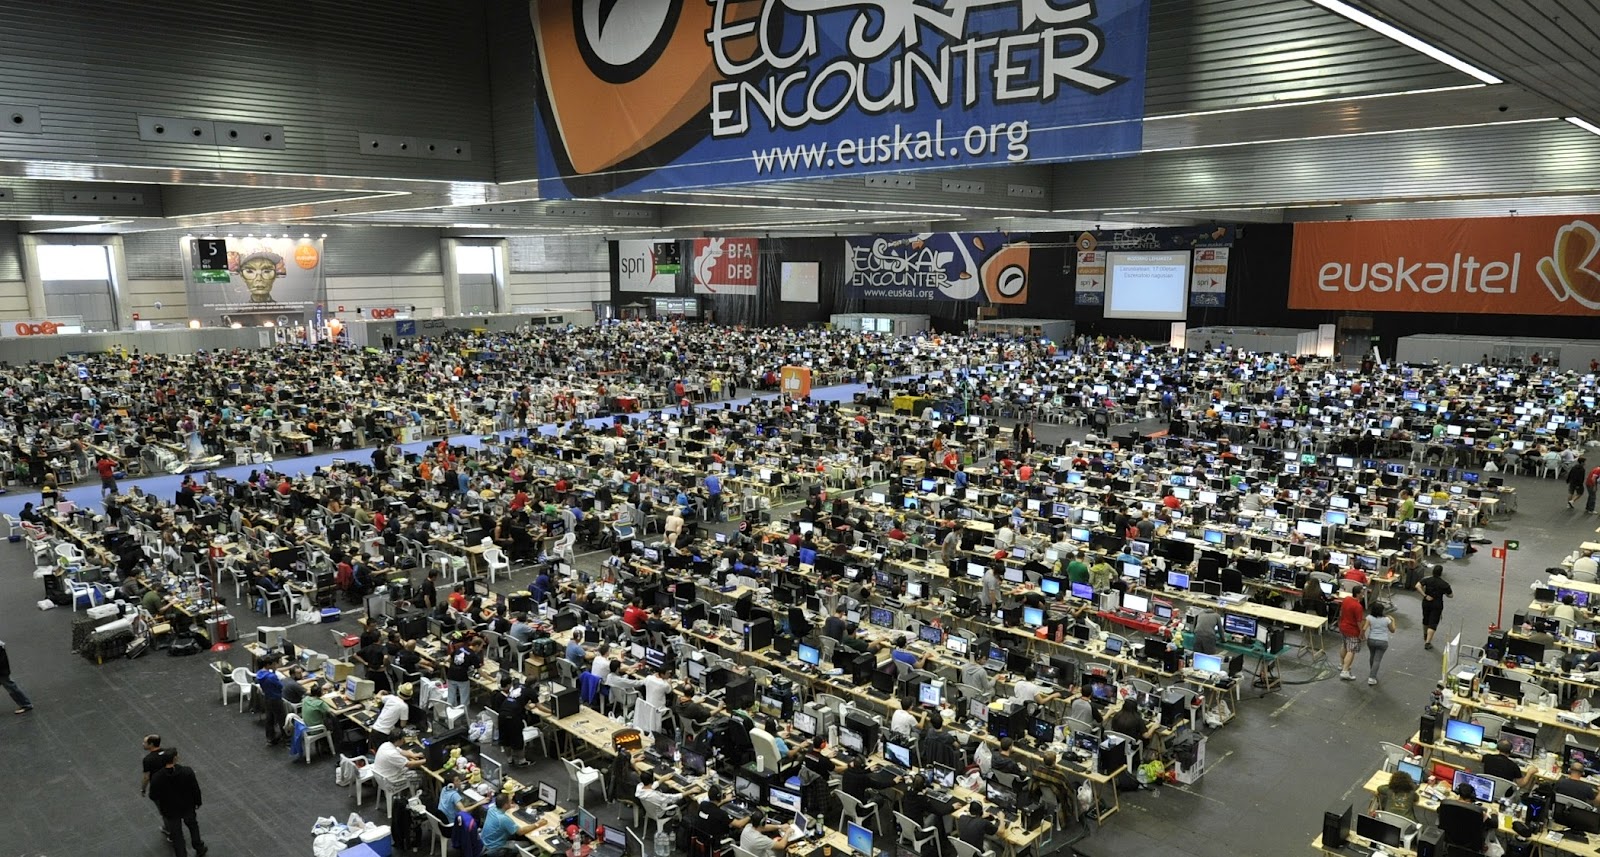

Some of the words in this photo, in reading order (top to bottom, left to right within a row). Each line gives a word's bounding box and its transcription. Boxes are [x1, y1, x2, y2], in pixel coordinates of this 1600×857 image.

[710, 27, 1115, 137] ENCOUNTER
[752, 119, 1030, 173] www.euskal.org
[208, 242, 218, 256] 5
[657, 244, 662, 255] 5
[670, 244, 676, 255] 5
[728, 243, 753, 259] BFA
[852, 237, 946, 273] EUSKAL
[621, 252, 645, 279] spri
[728, 264, 752, 279] DFB
[1317, 252, 1521, 294] euskaltel
[852, 271, 953, 288] ENCOUNTER
[864, 287, 934, 299] www.euskal.org
